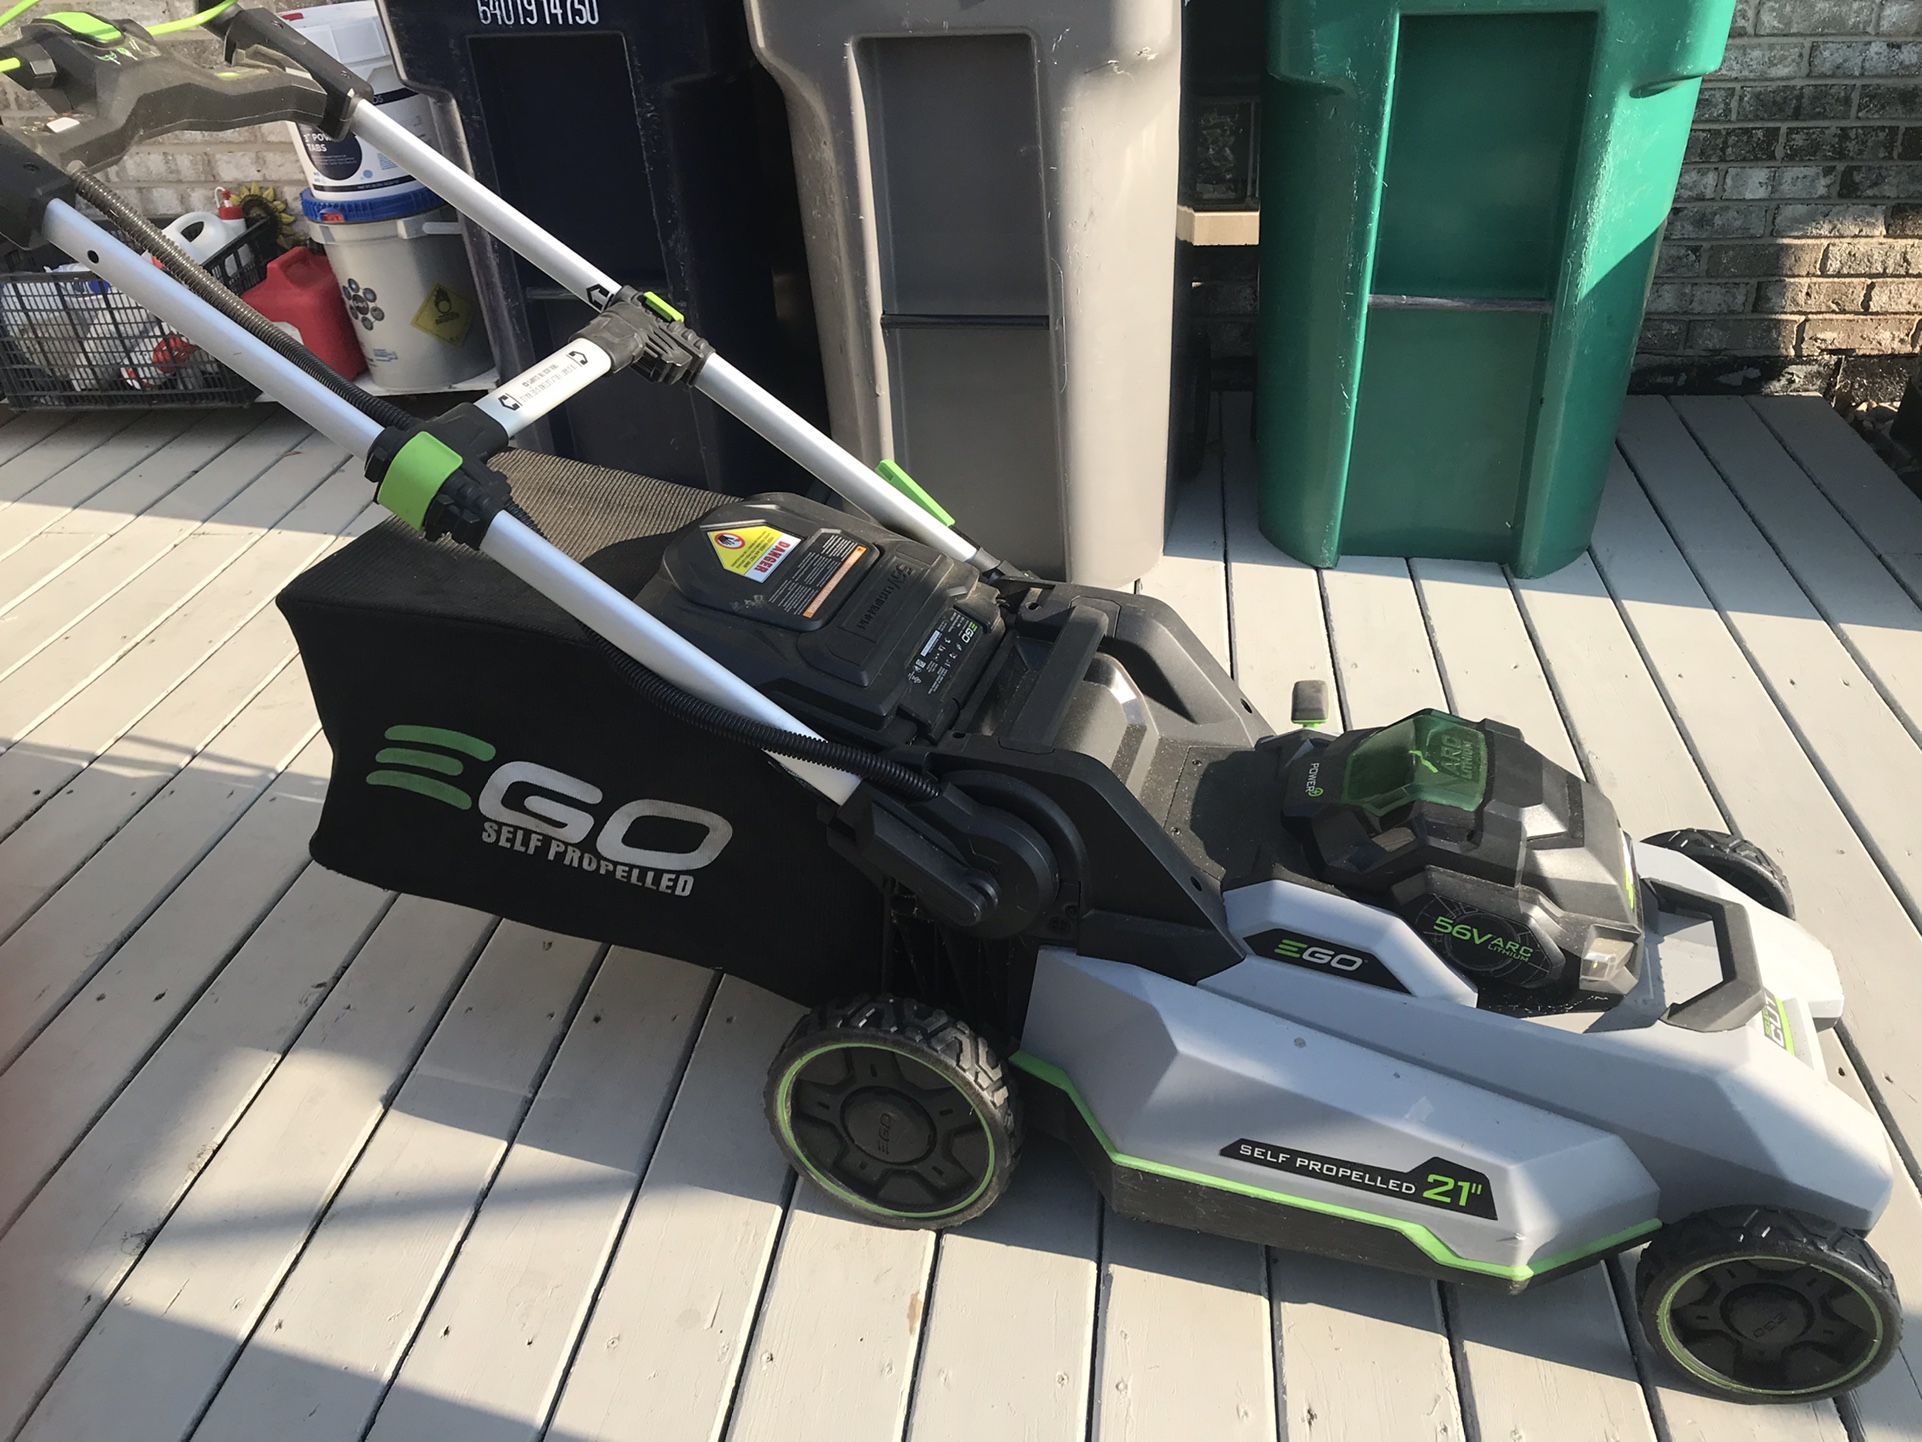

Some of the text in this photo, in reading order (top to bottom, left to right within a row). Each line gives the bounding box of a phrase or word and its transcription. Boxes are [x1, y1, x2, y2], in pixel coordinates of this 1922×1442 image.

[753, 540, 791, 574] DANGER
[961, 621, 979, 644] EGO
[366, 724, 733, 871] EGO
[481, 820, 695, 897] SELF PROPELLED
[1433, 916, 1534, 957] 56V ARC
[1487, 942, 1529, 963] LITHIUM
[1273, 939, 1364, 972] EGO
[1239, 1143, 1483, 1207] SELF PROPELLED 21"
